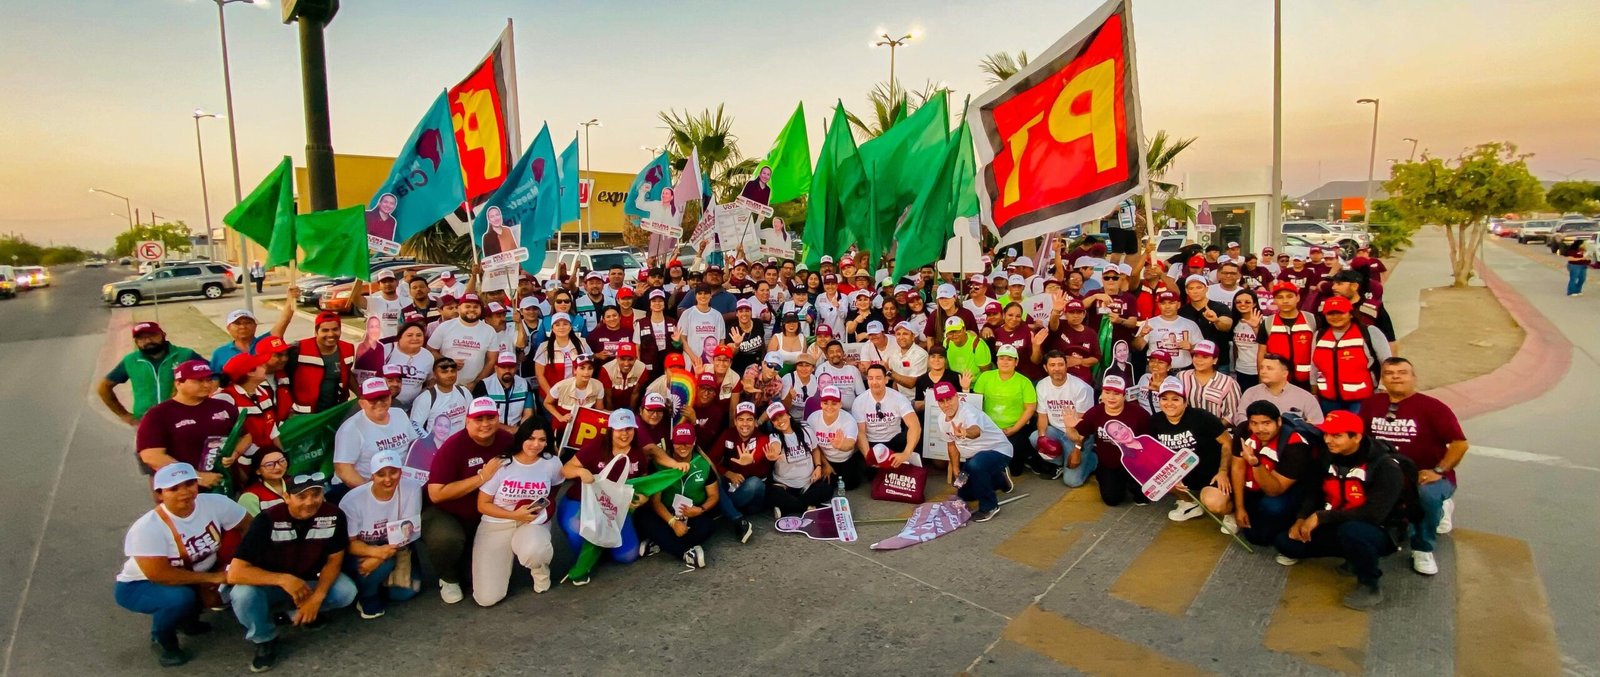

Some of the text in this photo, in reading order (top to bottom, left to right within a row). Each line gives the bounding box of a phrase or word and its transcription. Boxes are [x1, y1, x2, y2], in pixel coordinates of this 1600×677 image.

[146, 246, 155, 257] E
[1372, 417, 1416, 428] MILENA
[1371, 424, 1417, 433] QUIROGA
[376, 432, 408, 448] MILENA
[1157, 430, 1193, 442] MILENA
[885, 472, 917, 485] MILENA
[1153, 463, 1175, 483] MILENA
[502, 479, 547, 491] MILENA
[502, 487, 549, 496] QUIROGA
[361, 530, 388, 538] CLAU
